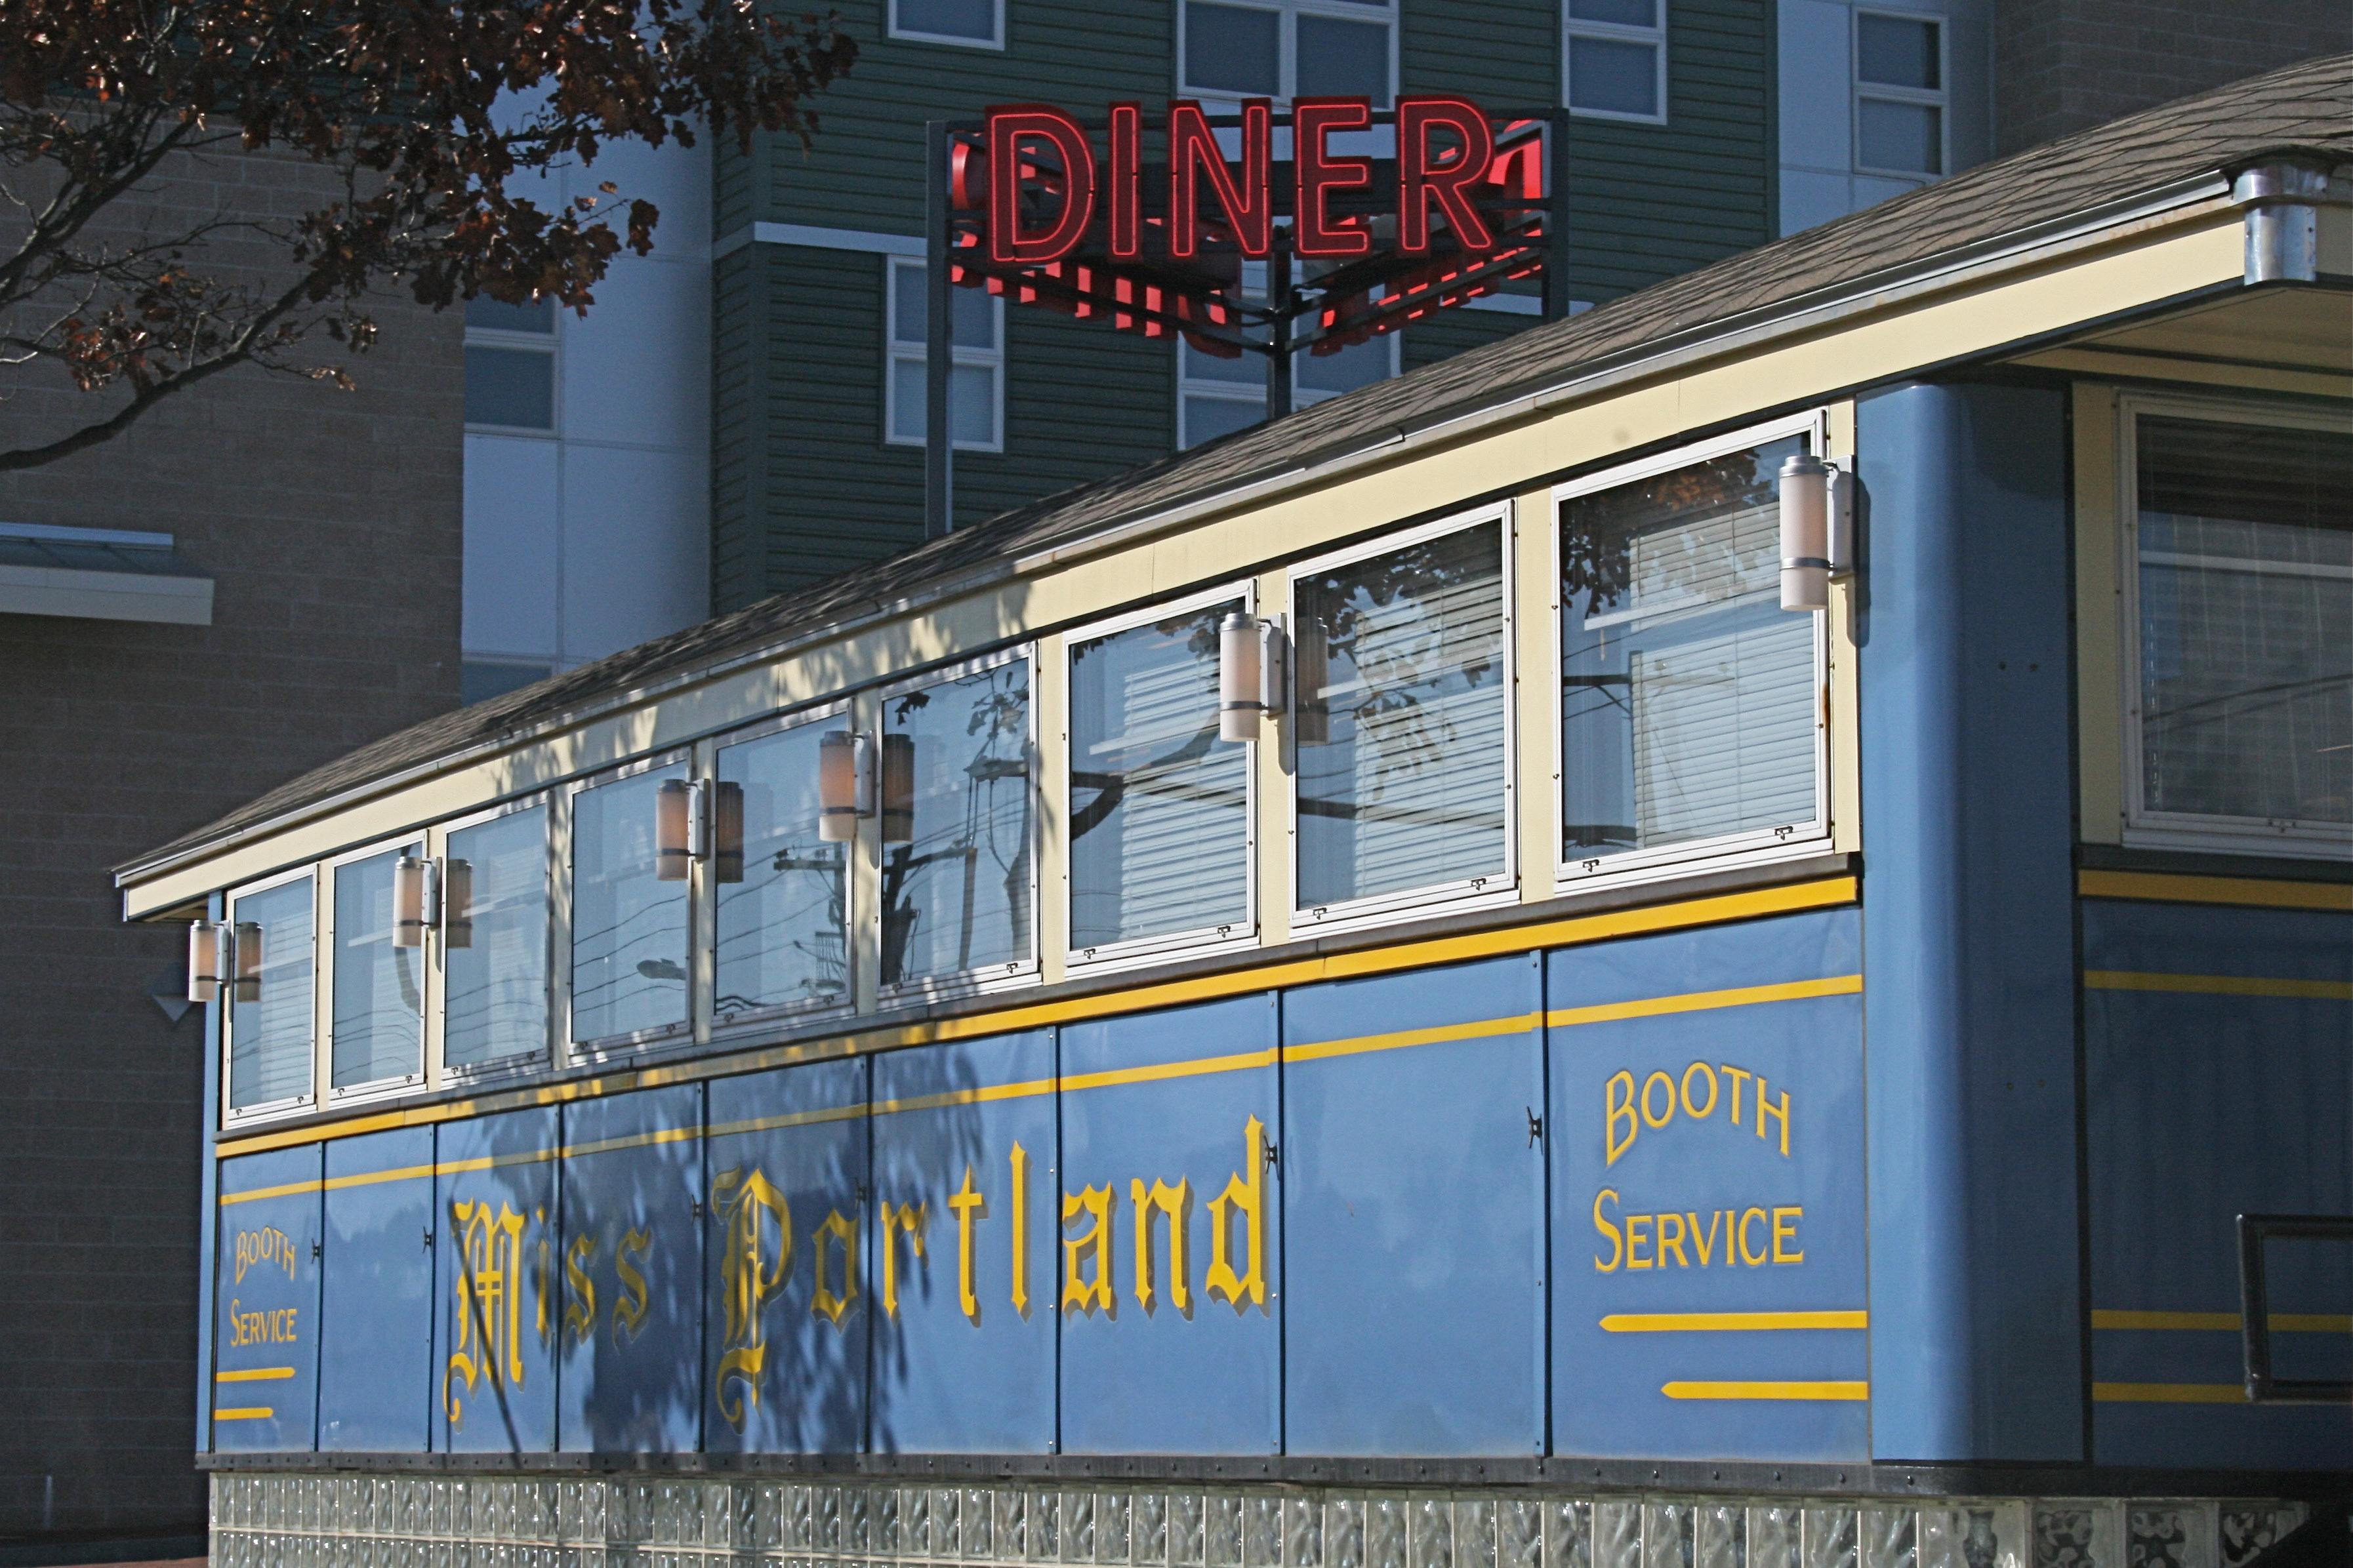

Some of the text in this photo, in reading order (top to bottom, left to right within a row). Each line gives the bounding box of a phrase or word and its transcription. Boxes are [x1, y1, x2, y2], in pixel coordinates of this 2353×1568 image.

[985, 95, 1501, 264] DINER
[1605, 1062, 1790, 1166] BOOTH
[235, 1226, 295, 1285] BOOTH
[443, 1113, 1264, 1422] Miss Portland
[1593, 1189, 1804, 1273] SERVICE
[231, 1298, 297, 1346] SERVICE
